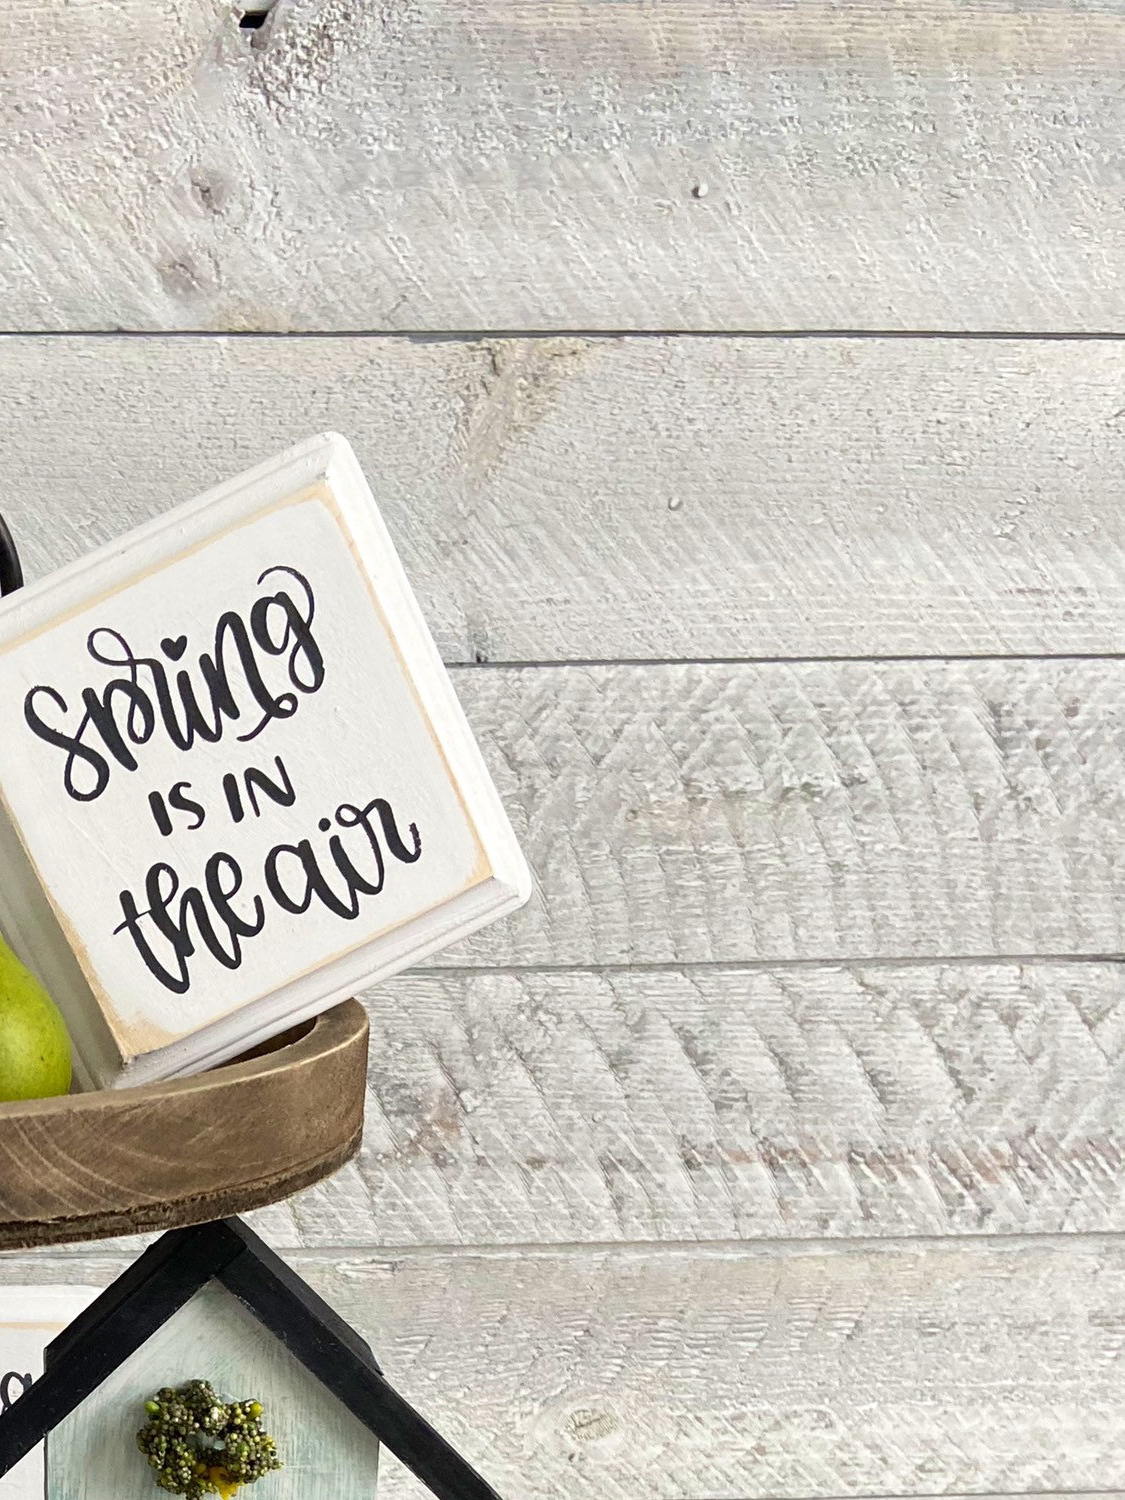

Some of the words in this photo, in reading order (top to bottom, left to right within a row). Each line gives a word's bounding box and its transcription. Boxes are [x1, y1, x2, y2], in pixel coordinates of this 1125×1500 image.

[148, 781, 205, 837] IS
[223, 756, 296, 823] IN
[114, 852, 265, 994] the
[264, 798, 421, 920] air
